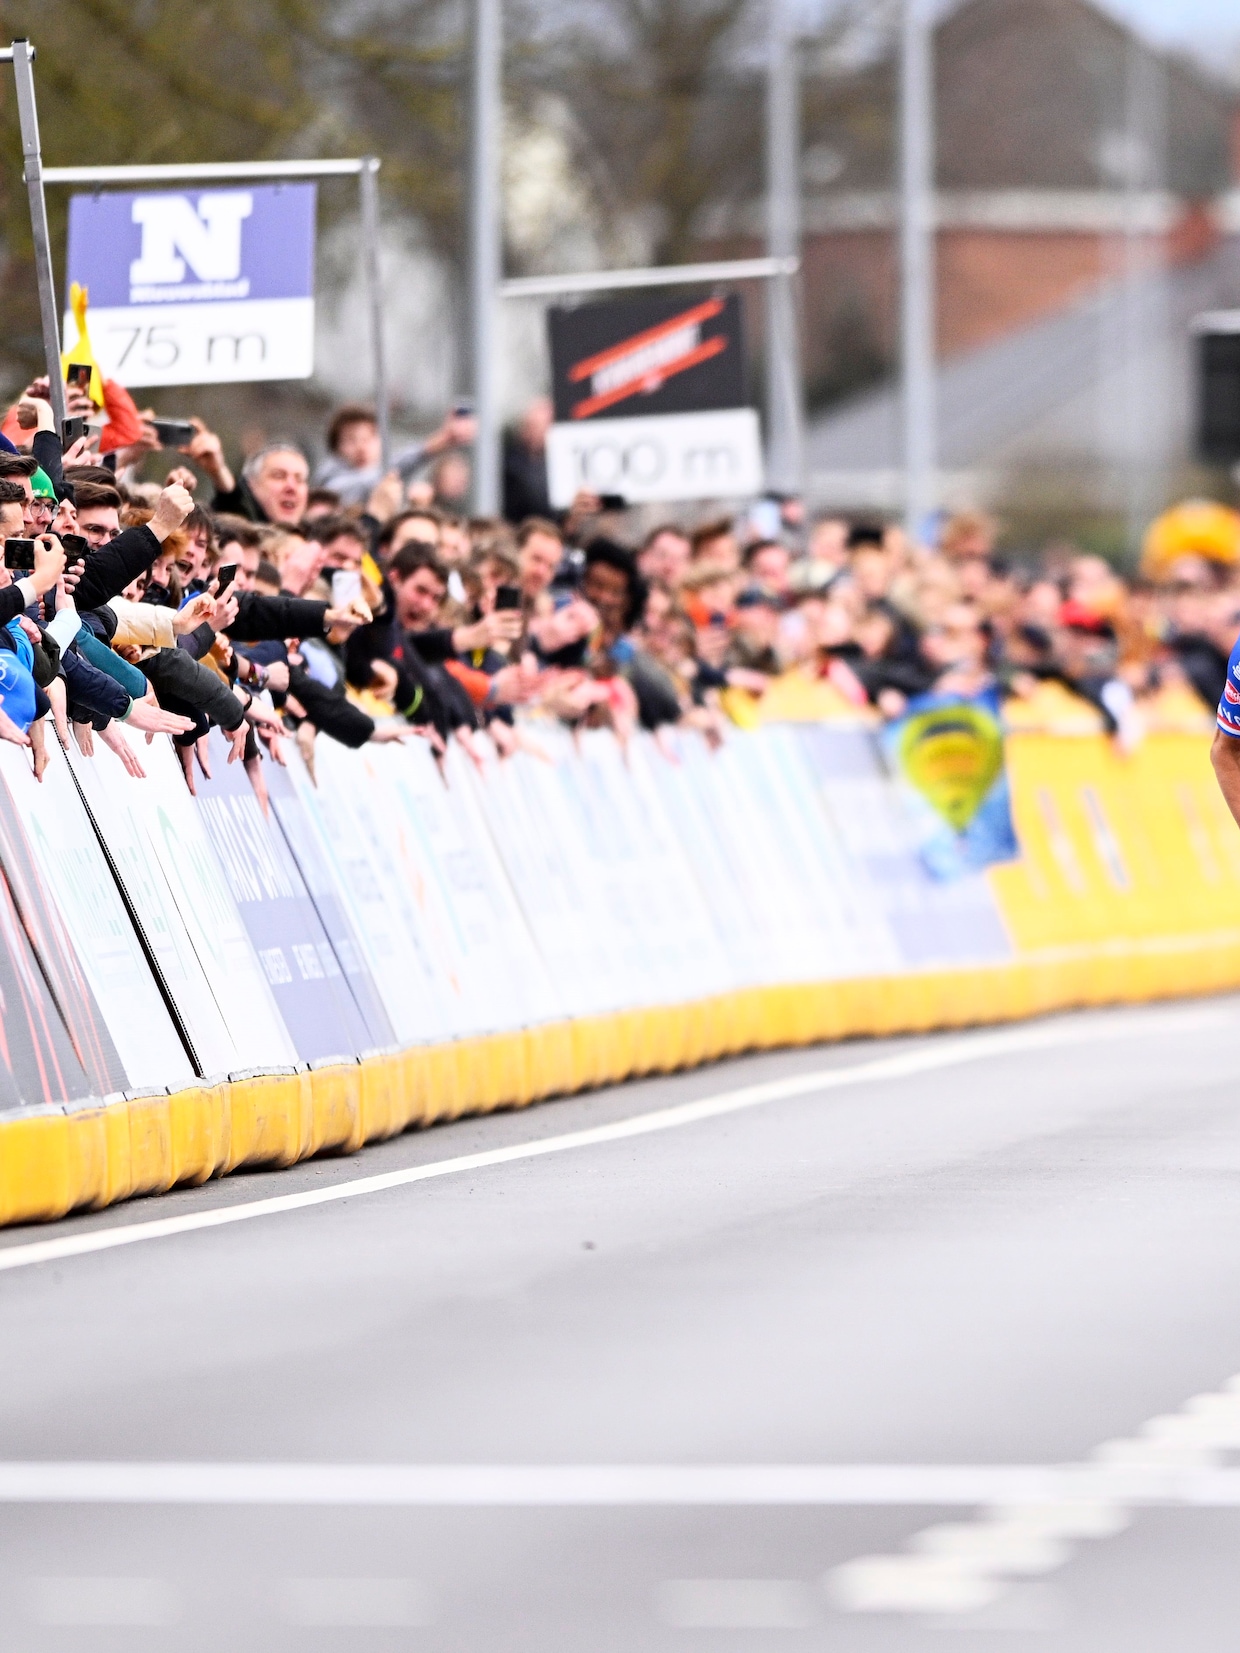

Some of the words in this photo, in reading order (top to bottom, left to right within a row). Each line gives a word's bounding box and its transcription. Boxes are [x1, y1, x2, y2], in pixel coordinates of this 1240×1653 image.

[131, 192, 253, 284] N
[107, 325, 179, 370] 75
[206, 331, 267, 364] m
